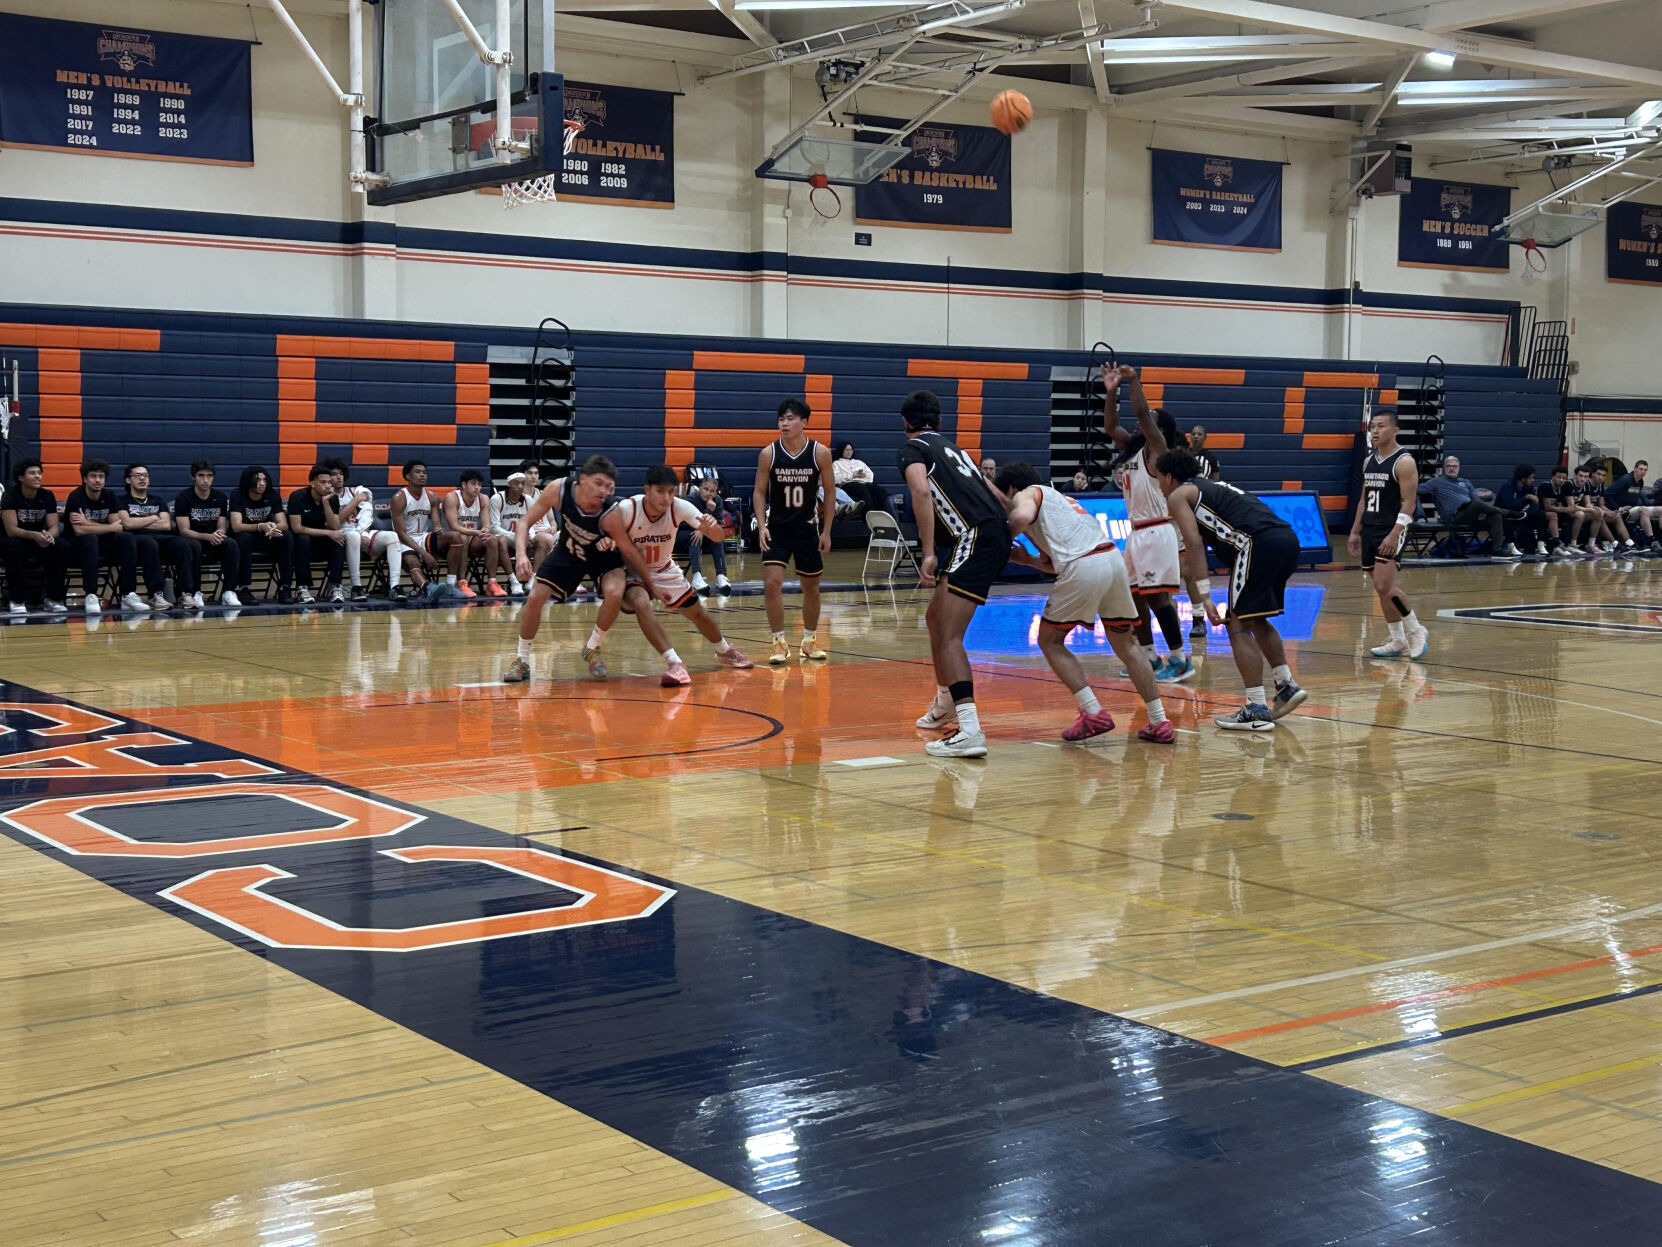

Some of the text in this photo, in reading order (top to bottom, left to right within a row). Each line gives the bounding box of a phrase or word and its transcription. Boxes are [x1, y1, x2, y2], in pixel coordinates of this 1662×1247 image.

[56, 69, 191, 95] MEN'S VOLLEYBALL
[66, 88, 185, 110] 1987 1989 1990
[68, 103, 186, 124] 1991 1994 2014
[67, 118, 188, 139] 2017 2022 2023
[67, 133, 97, 146] 2024
[571, 137, 665, 161] VOLLEYBALL
[563, 159, 626, 175] 1980 1982
[561, 172, 628, 188] 2006 2009
[913, 170, 997, 191] BASKETBALL
[923, 193, 943, 204] 1979
[1179, 187, 1255, 203] WOMEN'S BASKETBALL
[1232, 206, 1248, 215] 2024
[1422, 219, 1489, 237] MEN'S SOCCER
[1618, 238, 1656, 254] WOMEN'S
[774, 467, 813, 476] SANTIAGO
[777, 475, 809, 483] CANYON
[1364, 472, 1390, 481] SANTIAGO
[1364, 480, 1386, 488] CANYON
[784, 485, 804, 508] 10
[1366, 490, 1380, 513] 21
[633, 532, 672, 545] PIRATES
[645, 545, 661, 564] 11
